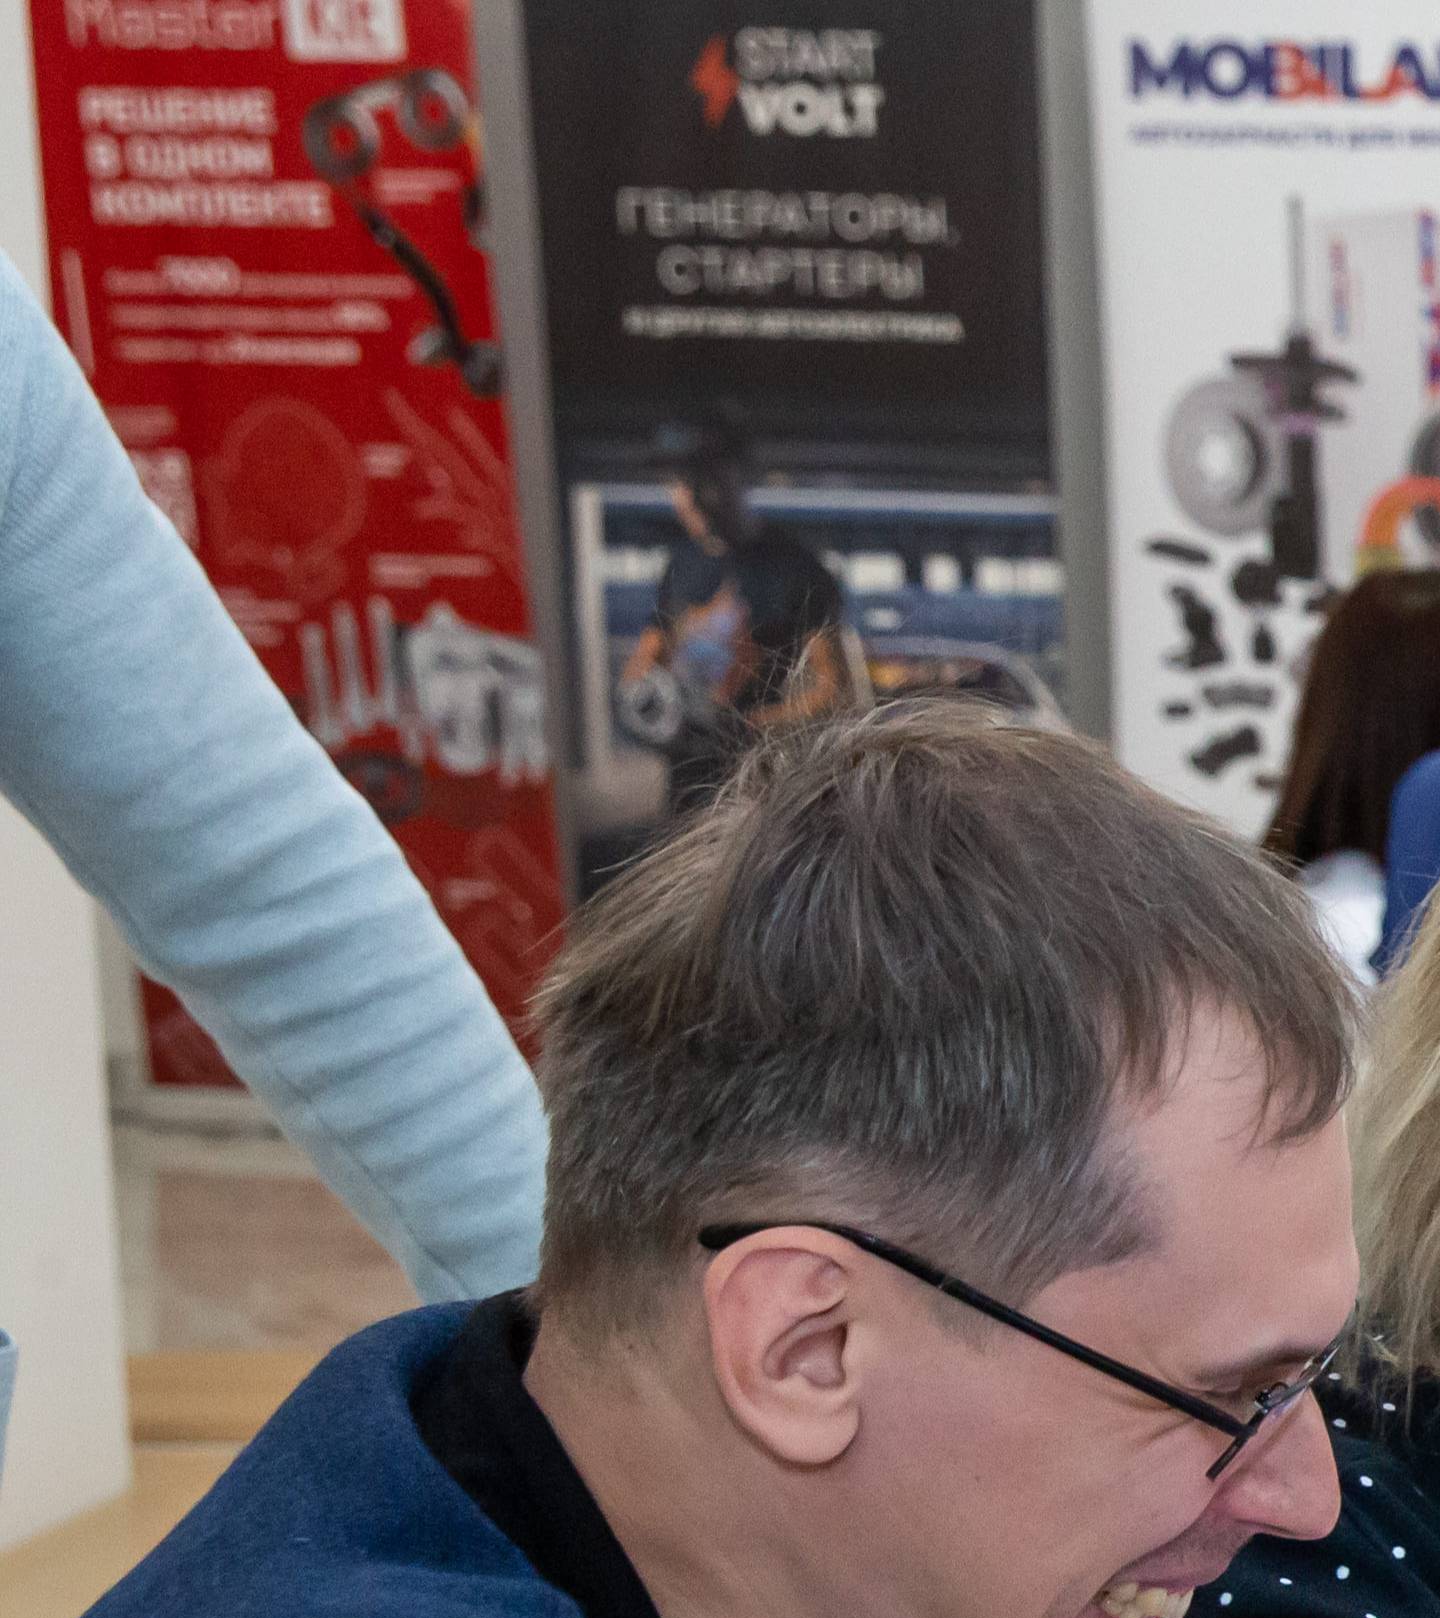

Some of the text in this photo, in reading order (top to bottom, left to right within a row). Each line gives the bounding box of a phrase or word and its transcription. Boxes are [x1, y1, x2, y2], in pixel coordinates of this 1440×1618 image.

[735, 27, 882, 80] START
[78, 84, 276, 133] РЕШЕНИЕ
[737, 82, 884, 137] VOLT
[656, 244, 923, 300] СТАРТЕРЫ
